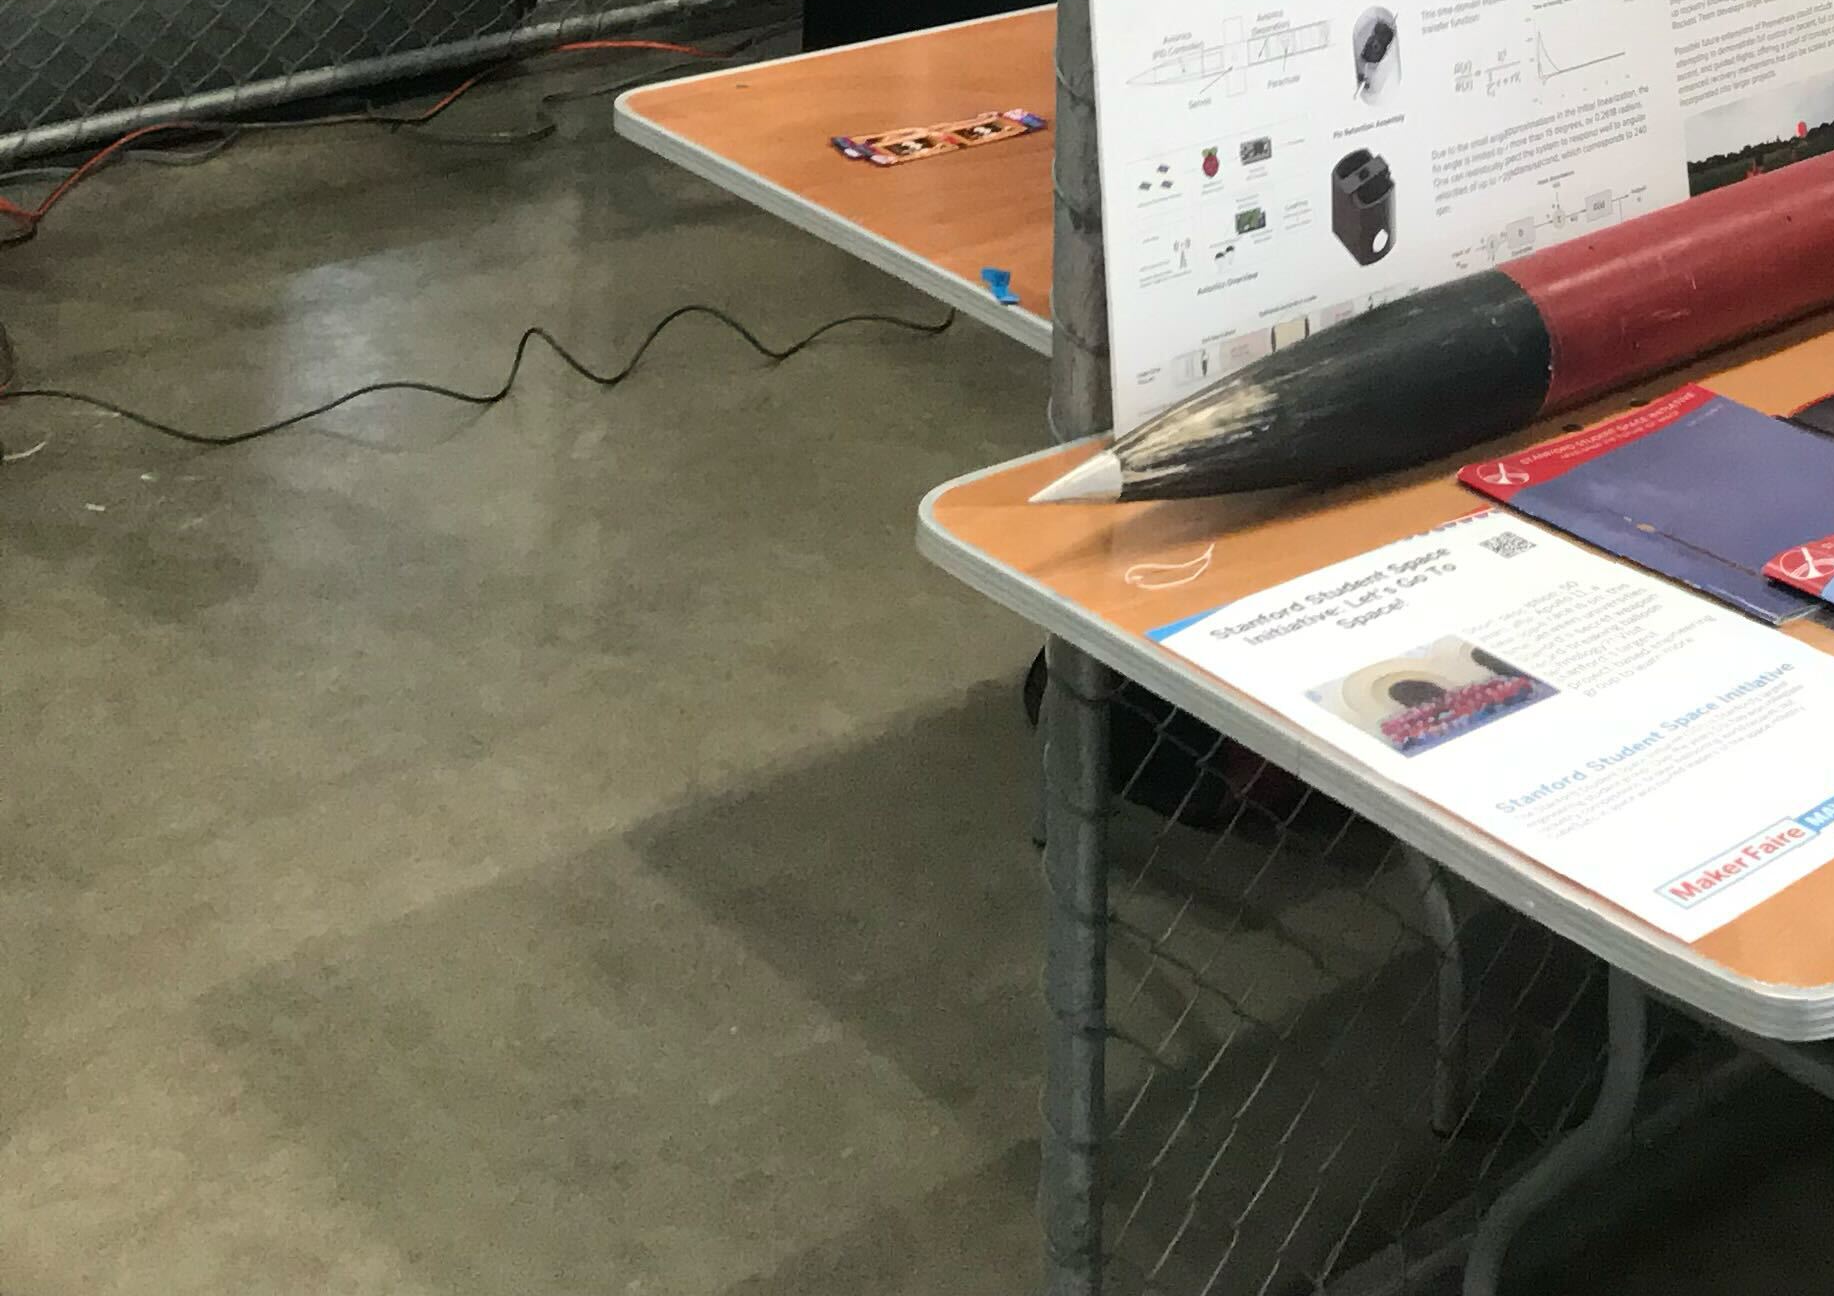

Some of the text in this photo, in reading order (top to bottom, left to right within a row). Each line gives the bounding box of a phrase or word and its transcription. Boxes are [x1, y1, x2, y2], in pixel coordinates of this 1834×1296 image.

[1210, 546, 1451, 641] Stanford Student Space
[1398, 573, 1428, 588] Go
[1431, 562, 1458, 576] To
[1496, 661, 1796, 815] Stanford Student Space Initiative
[1668, 825, 1806, 902] Maker Faire
